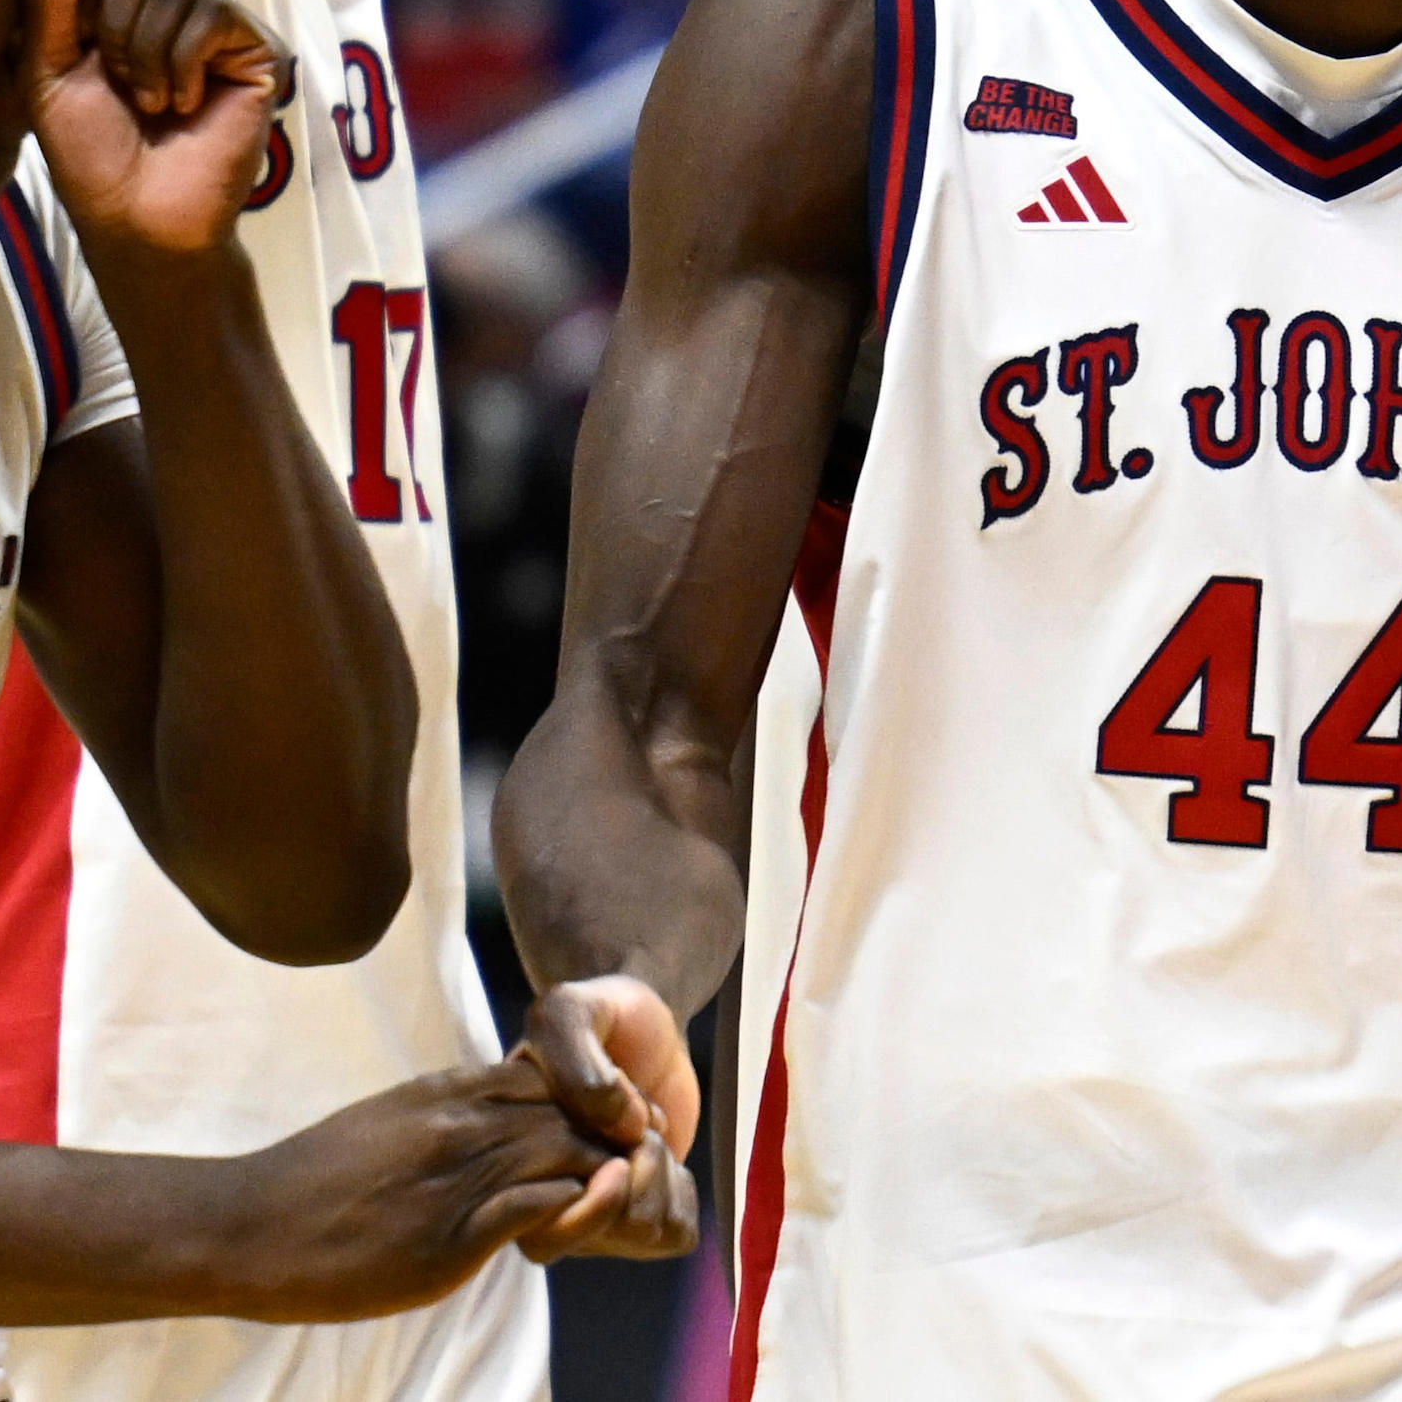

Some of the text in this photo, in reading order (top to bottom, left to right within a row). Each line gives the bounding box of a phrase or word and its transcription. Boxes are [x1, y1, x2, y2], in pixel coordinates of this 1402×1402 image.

[981, 79, 1068, 113] BE THE
[967, 103, 1075, 135] CHANGE
[980, 323, 1154, 529] ST.
